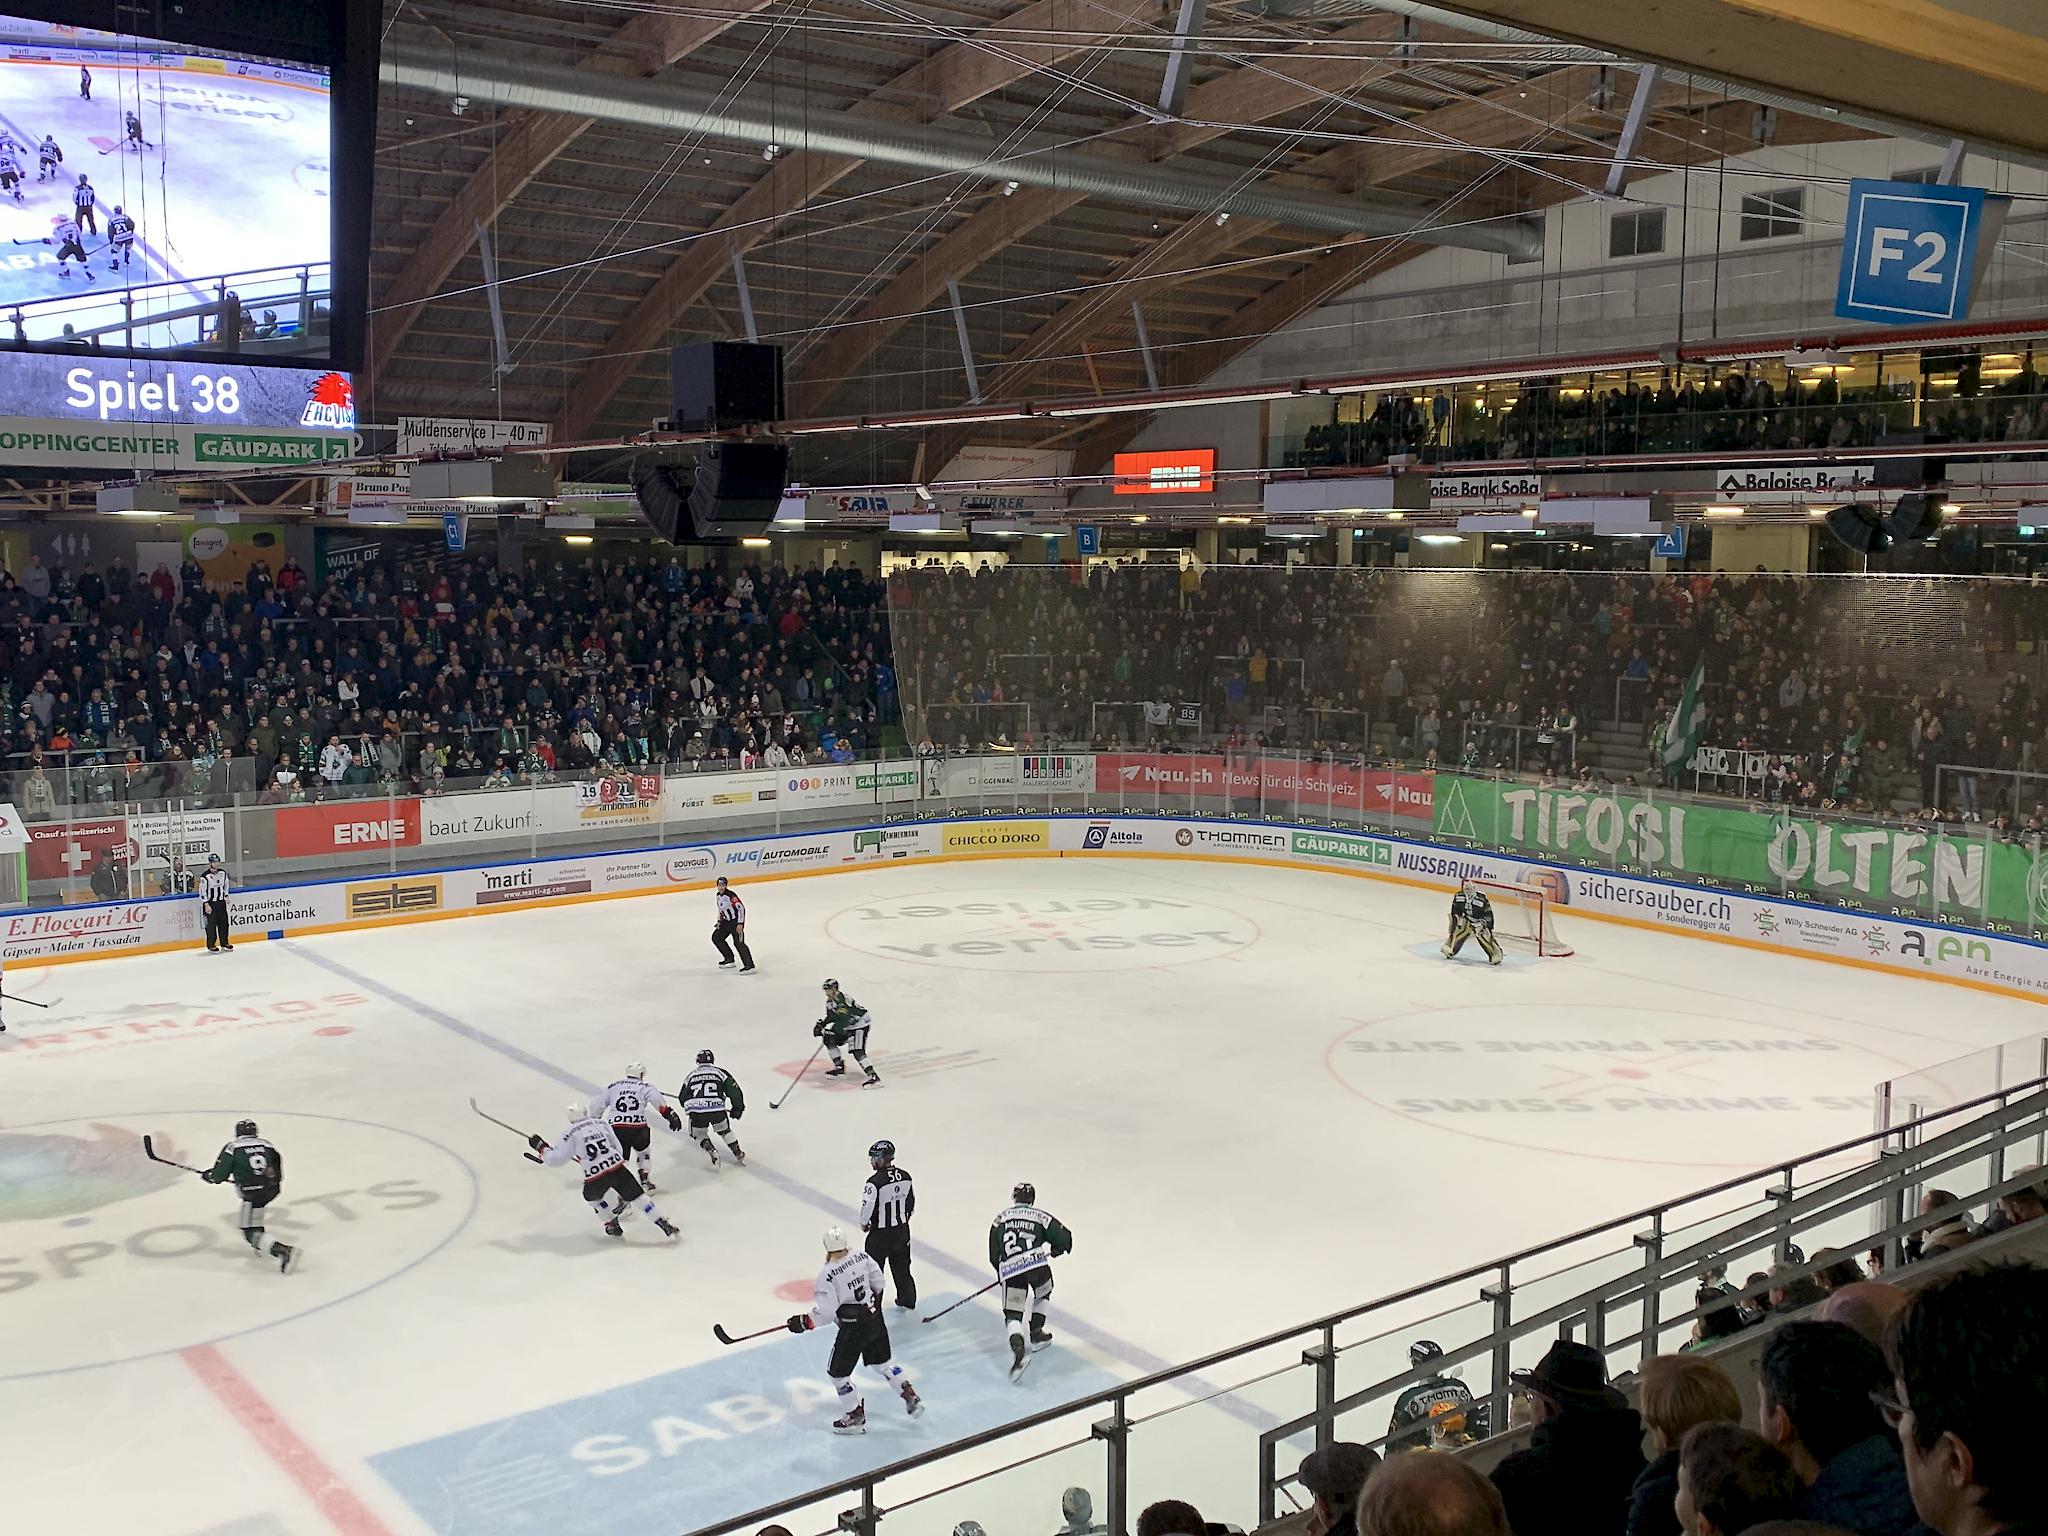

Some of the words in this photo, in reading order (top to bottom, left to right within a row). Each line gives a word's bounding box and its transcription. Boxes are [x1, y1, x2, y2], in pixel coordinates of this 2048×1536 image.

[1868, 226, 1947, 285] F2
[66, 367, 181, 420] Spiel
[191, 375, 240, 415] 38
[403, 419, 486, 440] Muldenservice
[201, 435, 317, 461] GÄUPARK
[356, 482, 389, 492] Bruno
[1461, 480, 1499, 497] Bank
[1501, 480, 1540, 495] SoBa
[1746, 471, 1812, 490] Baloise
[1083, 533, 1091, 546] B
[1664, 535, 1675, 548] A
[823, 776, 852, 787] PRINT
[1144, 766, 1214, 784] Nau.ch
[1221, 771, 1261, 786] News
[1263, 772, 1282, 789] für
[1284, 773, 1304, 790] die
[1305, 777, 1357, 797] Schweiz.
[582, 786, 597, 798] 19
[34, 830, 60, 839] Chauf
[334, 819, 406, 845] ERNE
[429, 816, 468, 838] baut
[1110, 831, 1143, 841] Altola
[1503, 789, 1686, 869] TIFOSI
[949, 835, 998, 846] CHICCO
[1196, 830, 1286, 847] THOMMEN
[1296, 837, 1370, 857] GÄUPARK
[673, 858, 709, 869] BOUYGUES
[725, 850, 759, 864] HUG
[762, 845, 830, 860] AUTOMOBILE
[616, 864, 640, 872] Partner
[1397, 851, 1483, 879] NUSSBAUM
[1767, 821, 1984, 909] OLTEN
[486, 868, 532, 890] marti
[503, 884, 567, 899] www.marti-ag.com
[1579, 877, 1731, 921] sichersauber.ch
[230, 897, 292, 914] Aargauische
[7, 918, 27, 937] E.
[31, 908, 114, 934] Floccari
[117, 904, 149, 925] AG
[230, 905, 317, 928] Kantonalbank
[1665, 912, 1717, 932] Sonderegger
[1718, 922, 1731, 933] AG
[1784, 916, 1803, 928] Willy
[1804, 919, 1843, 933] Schneider
[1845, 926, 1858, 936] AG
[2, 945, 42, 959] Gipsen
[49, 940, 85, 953] Malen
[92, 934, 142, 949] Fassaden
[1965, 964, 1990, 978] Aare
[1994, 969, 2032, 988] Energie
[615, 1095, 640, 1113] 63
[1397, 1097, 1594, 1113] SWISS
[1606, 1096, 1803, 1113] PRIME
[585, 1138, 610, 1162] 95
[248, 1153, 268, 1176] 9
[887, 1169, 902, 1183] 56
